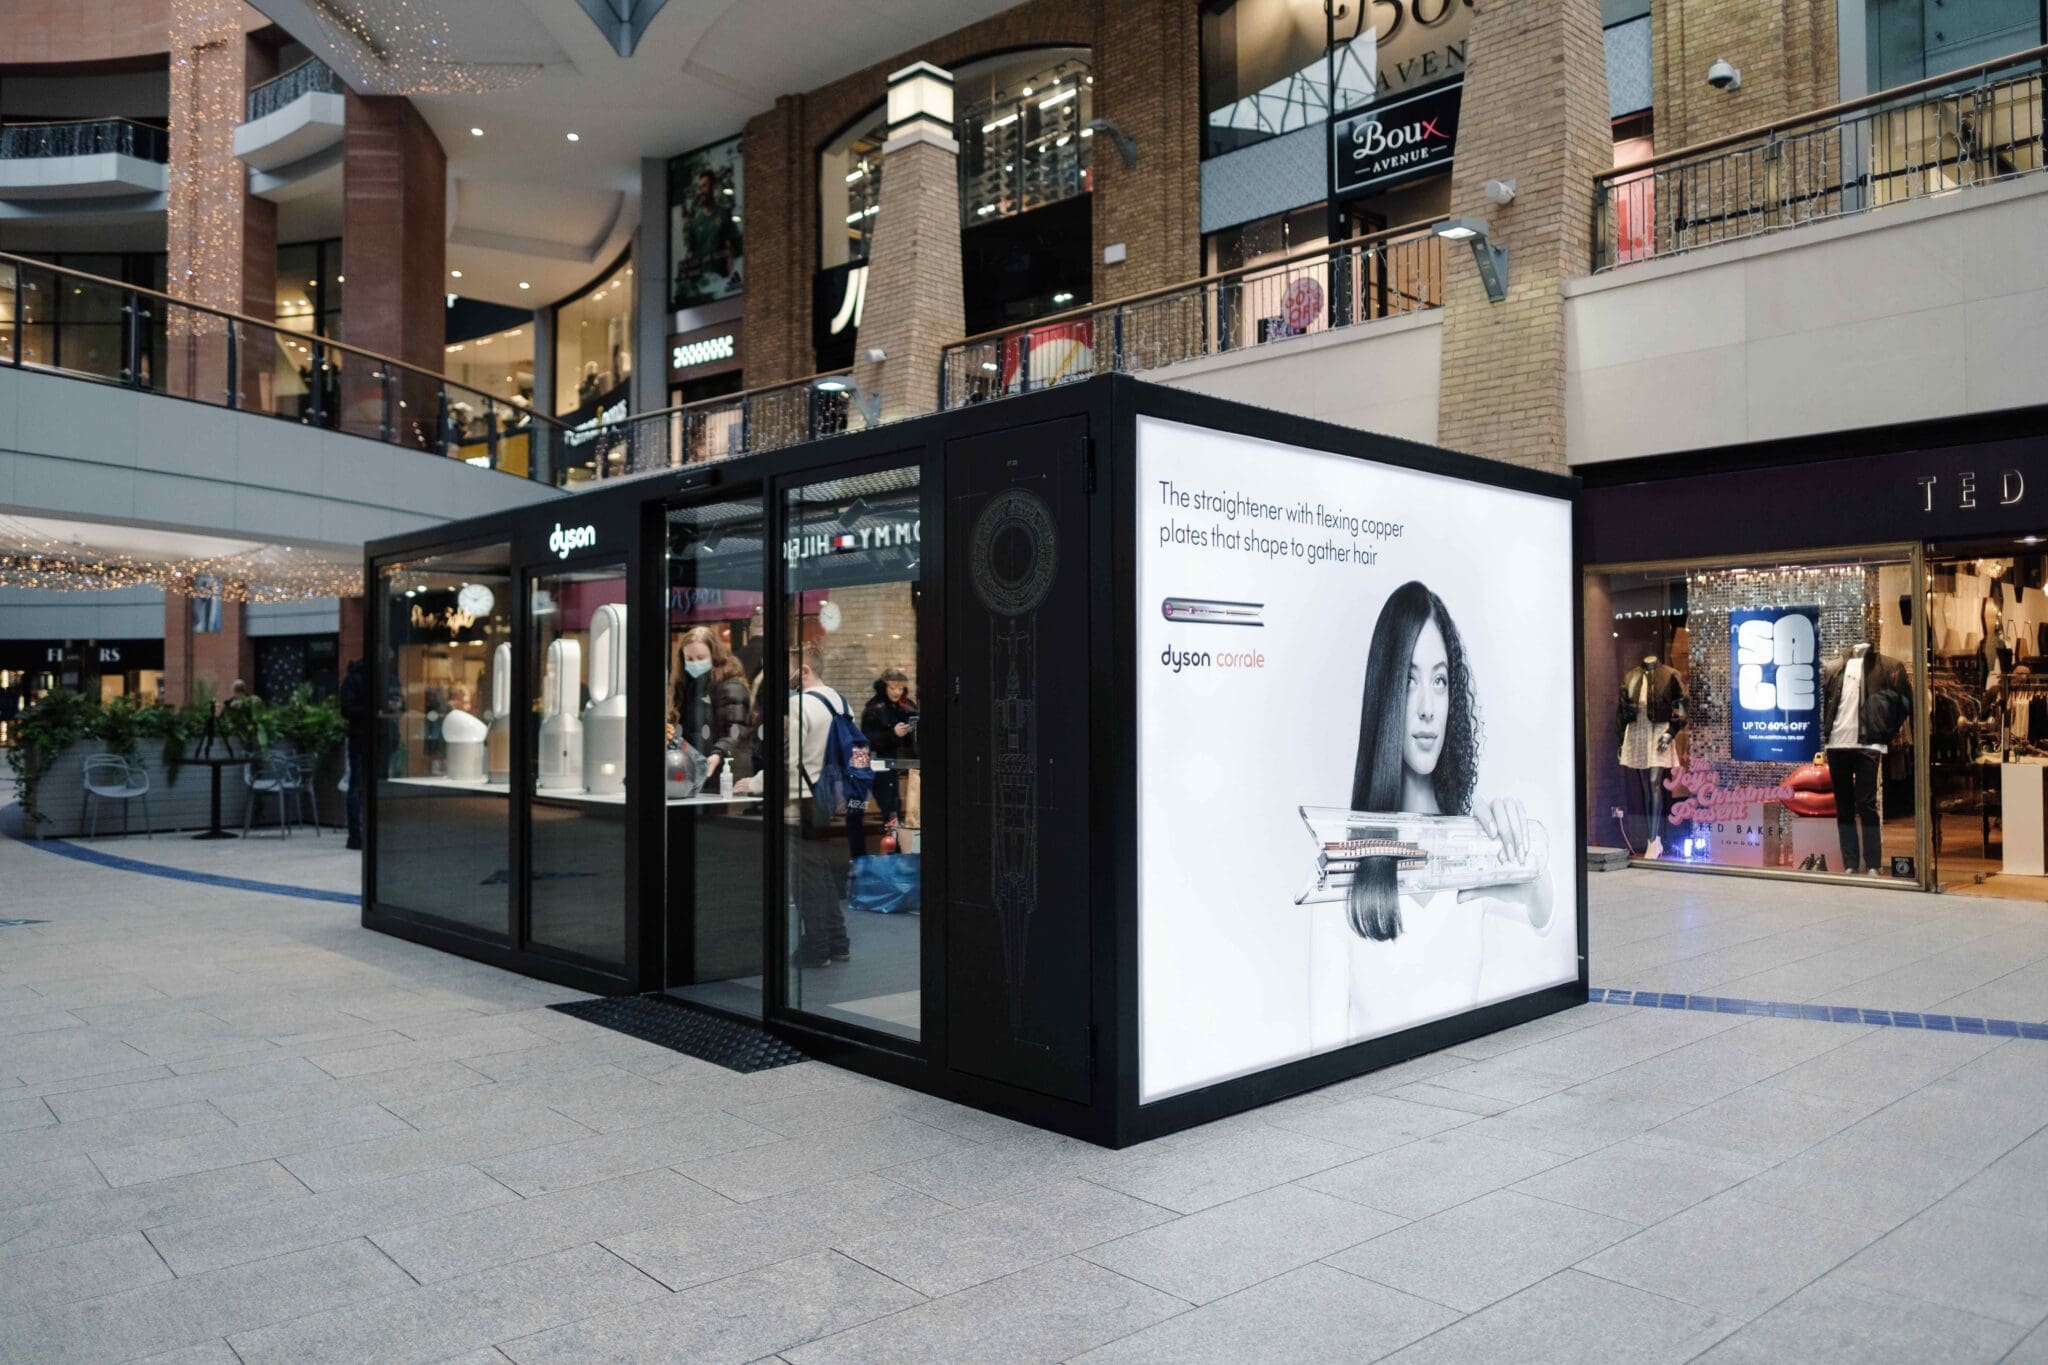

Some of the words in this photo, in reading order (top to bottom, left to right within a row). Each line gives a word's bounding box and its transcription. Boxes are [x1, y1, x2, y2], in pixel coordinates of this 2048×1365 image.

[1376, 39, 1468, 91] AVEN
[1352, 117, 1450, 160] Boux
[1373, 147, 1429, 173] AVENUE
[1916, 469, 2025, 512] TED
[1159, 480, 1190, 508] The
[1194, 489, 1283, 520] straightener
[1286, 502, 1313, 525] with
[1317, 503, 1359, 537] flexing
[1361, 517, 1404, 541] copper
[550, 523, 596, 559] dyson
[1160, 518, 1208, 548] plates
[1211, 524, 1240, 550] that
[1244, 528, 1288, 559] shape
[1290, 537, 1304, 557] to
[1307, 539, 1350, 564] gather
[1353, 542, 1378, 565] hair
[1161, 643, 1211, 673] dyson
[1216, 648, 1264, 668] corrale
[1742, 721, 1754, 730] UP
[1755, 721, 1767, 730] TO
[1663, 767, 1707, 793] Joy
[1697, 783, 1795, 806] Christmas
[1668, 798, 1748, 826] Present
[1736, 825, 1784, 836] BAKER
